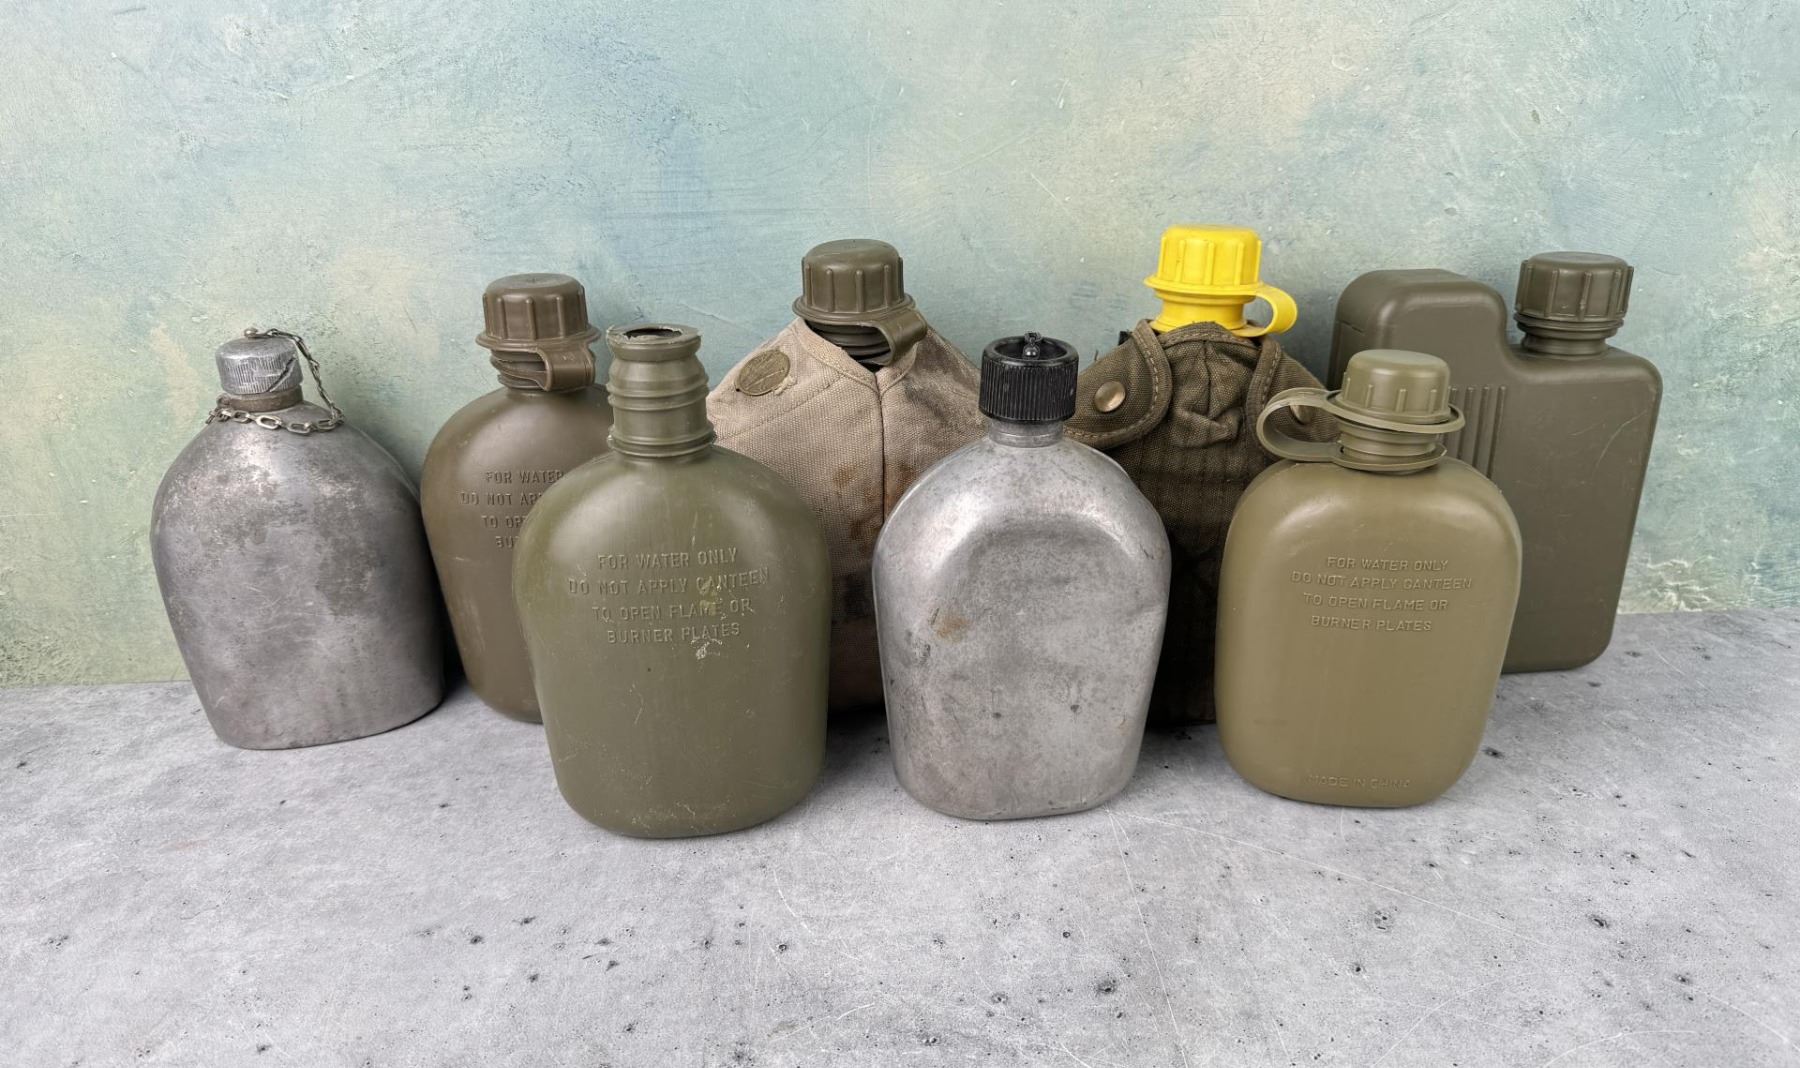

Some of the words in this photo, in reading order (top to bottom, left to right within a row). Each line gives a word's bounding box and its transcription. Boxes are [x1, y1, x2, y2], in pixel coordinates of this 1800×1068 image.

[486, 471, 512, 484] FOR
[459, 491, 479, 506] DO
[487, 493, 512, 506] NOT
[481, 515, 498, 529] TO
[506, 515, 527, 529] OP
[598, 554, 628, 570] FOR
[636, 552, 689, 570] WATER
[698, 547, 738, 565] ONLY
[1327, 556, 1356, 569] FOR
[1361, 558, 1409, 572] WATER
[1414, 560, 1449, 572] ONLY
[569, 578, 590, 595] DO
[599, 580, 628, 596] NOT
[638, 578, 688, 594] APPLY
[696, 567, 770, 590] CANTEEN
[1291, 570, 1312, 583] DO
[1317, 573, 1346, 587] NOT
[1350, 577, 1398, 590] APPLY
[1403, 577, 1473, 590] CANTEEN
[592, 606, 612, 622] TO
[620, 605, 662, 621] OPEN
[669, 600, 723, 619] FLAME
[730, 598, 752, 614] OR
[1303, 592, 1322, 606] TO
[1328, 596, 1368, 609] OPEN
[1372, 598, 1426, 611] FLAME
[1430, 599, 1449, 611] OR
[1311, 615, 1371, 630] BURNER
[1376, 619, 1433, 632] PLATES
[607, 629, 674, 645] BURNER
[681, 622, 741, 641] PLATES
